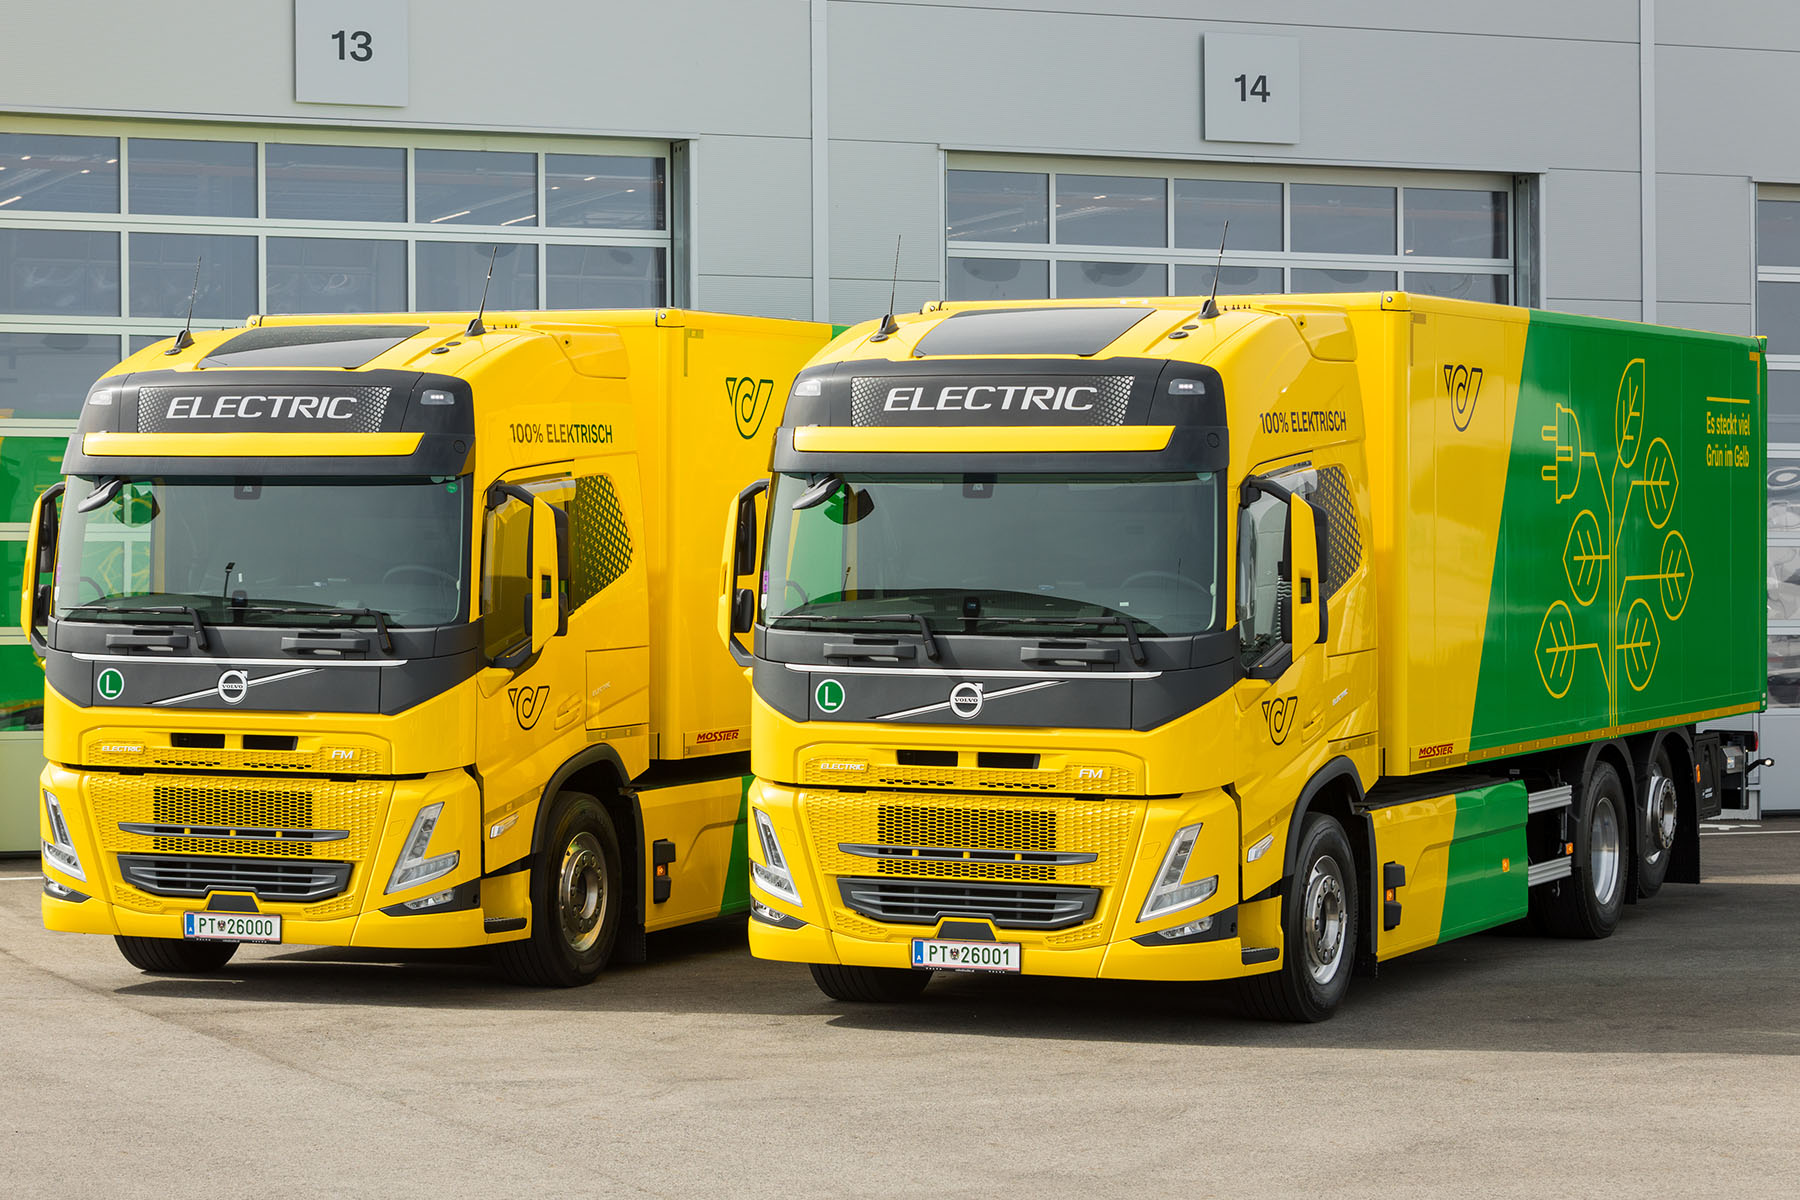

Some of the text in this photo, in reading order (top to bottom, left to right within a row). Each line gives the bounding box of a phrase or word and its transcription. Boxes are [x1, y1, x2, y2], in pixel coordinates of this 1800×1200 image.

[331, 30, 373, 62] 13
[1234, 74, 1271, 103] 14
[166, 395, 357, 419] ELECTRIC
[883, 386, 1098, 412] ELECTRIC
[1259, 410, 1347, 434] 100% ELEKTRISCH
[1706, 411, 1750, 436] Es steckt viel
[509, 423, 613, 444] 100% ELEKTRISCH
[1706, 443, 1750, 468] Grün im Gelb
[106, 674, 117, 694] L
[825, 686, 837, 707] L
[331, 750, 354, 759] FM
[820, 763, 865, 771] ELECTRIC
[1079, 768, 1104, 779] FM
[198, 917, 273, 936] PT 26000
[929, 945, 1009, 966] PT 26001
